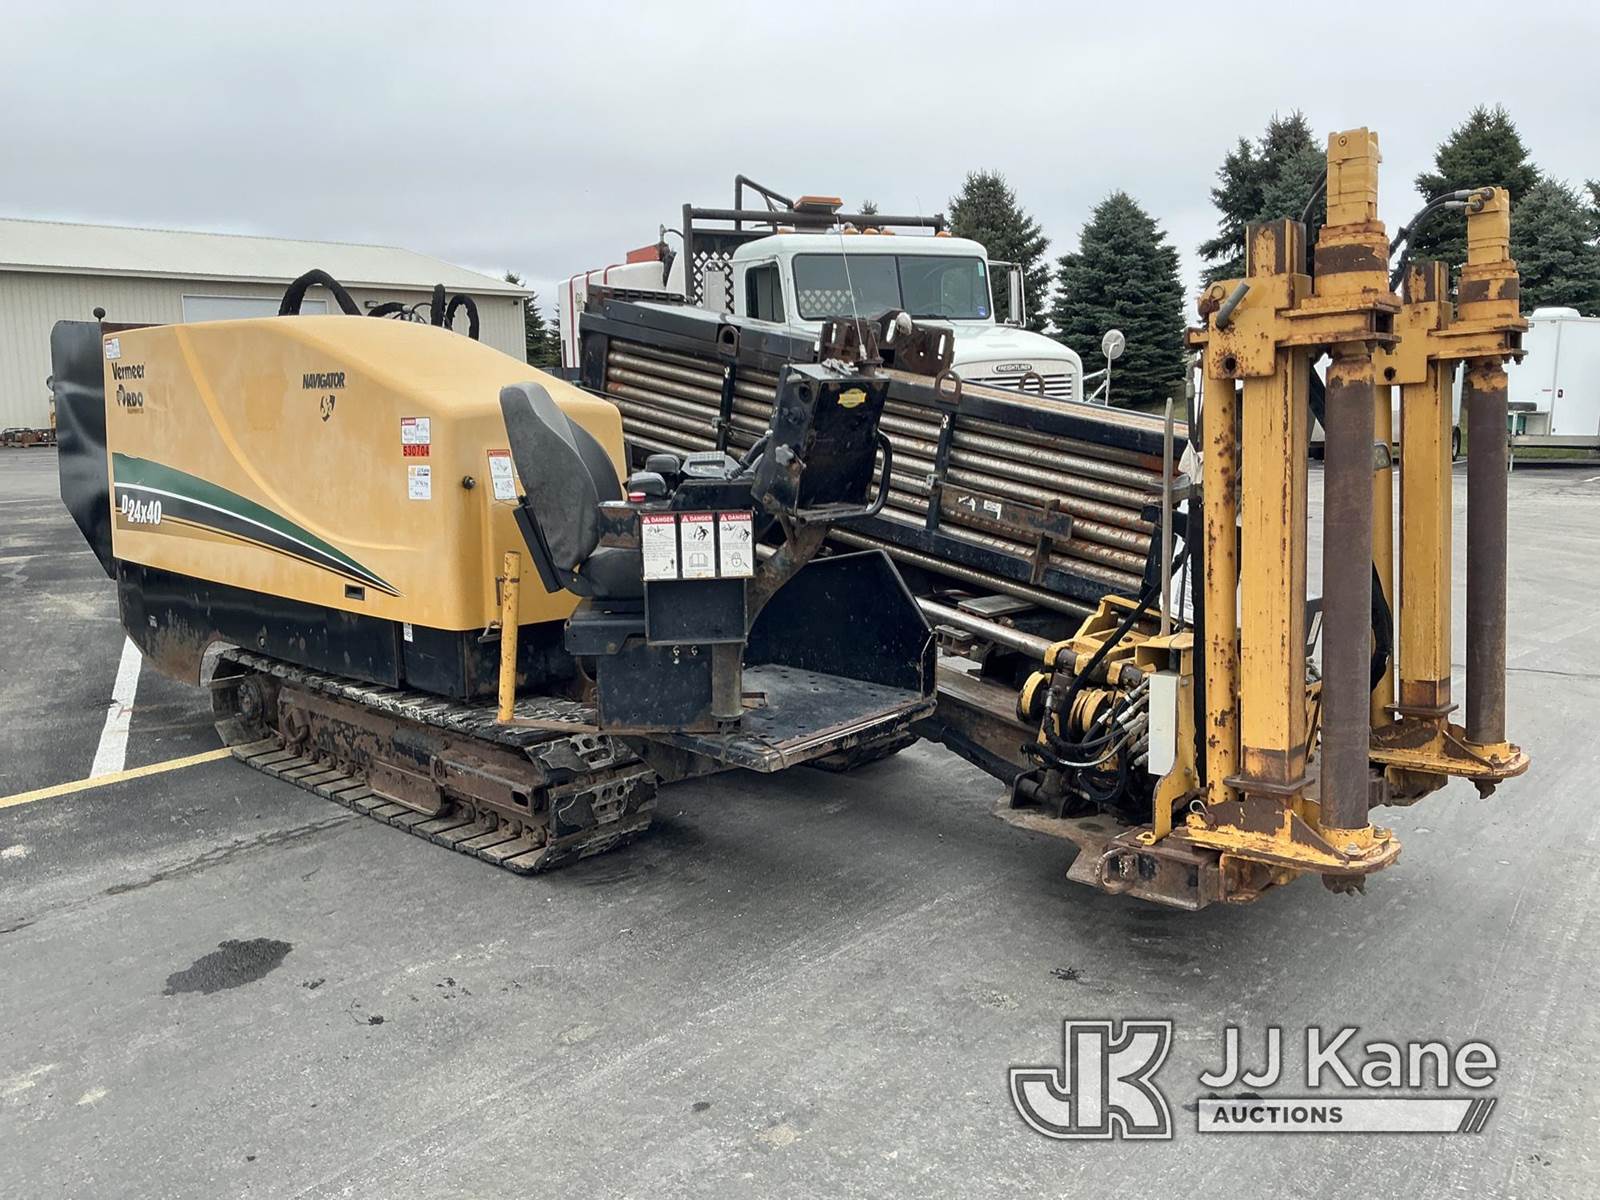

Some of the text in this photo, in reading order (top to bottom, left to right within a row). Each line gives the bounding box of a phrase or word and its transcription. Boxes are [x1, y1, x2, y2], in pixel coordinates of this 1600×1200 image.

[112, 362, 144, 381] Vermeer
[303, 372, 345, 389] NAVIGATOR
[121, 494, 162, 525] D24x40
